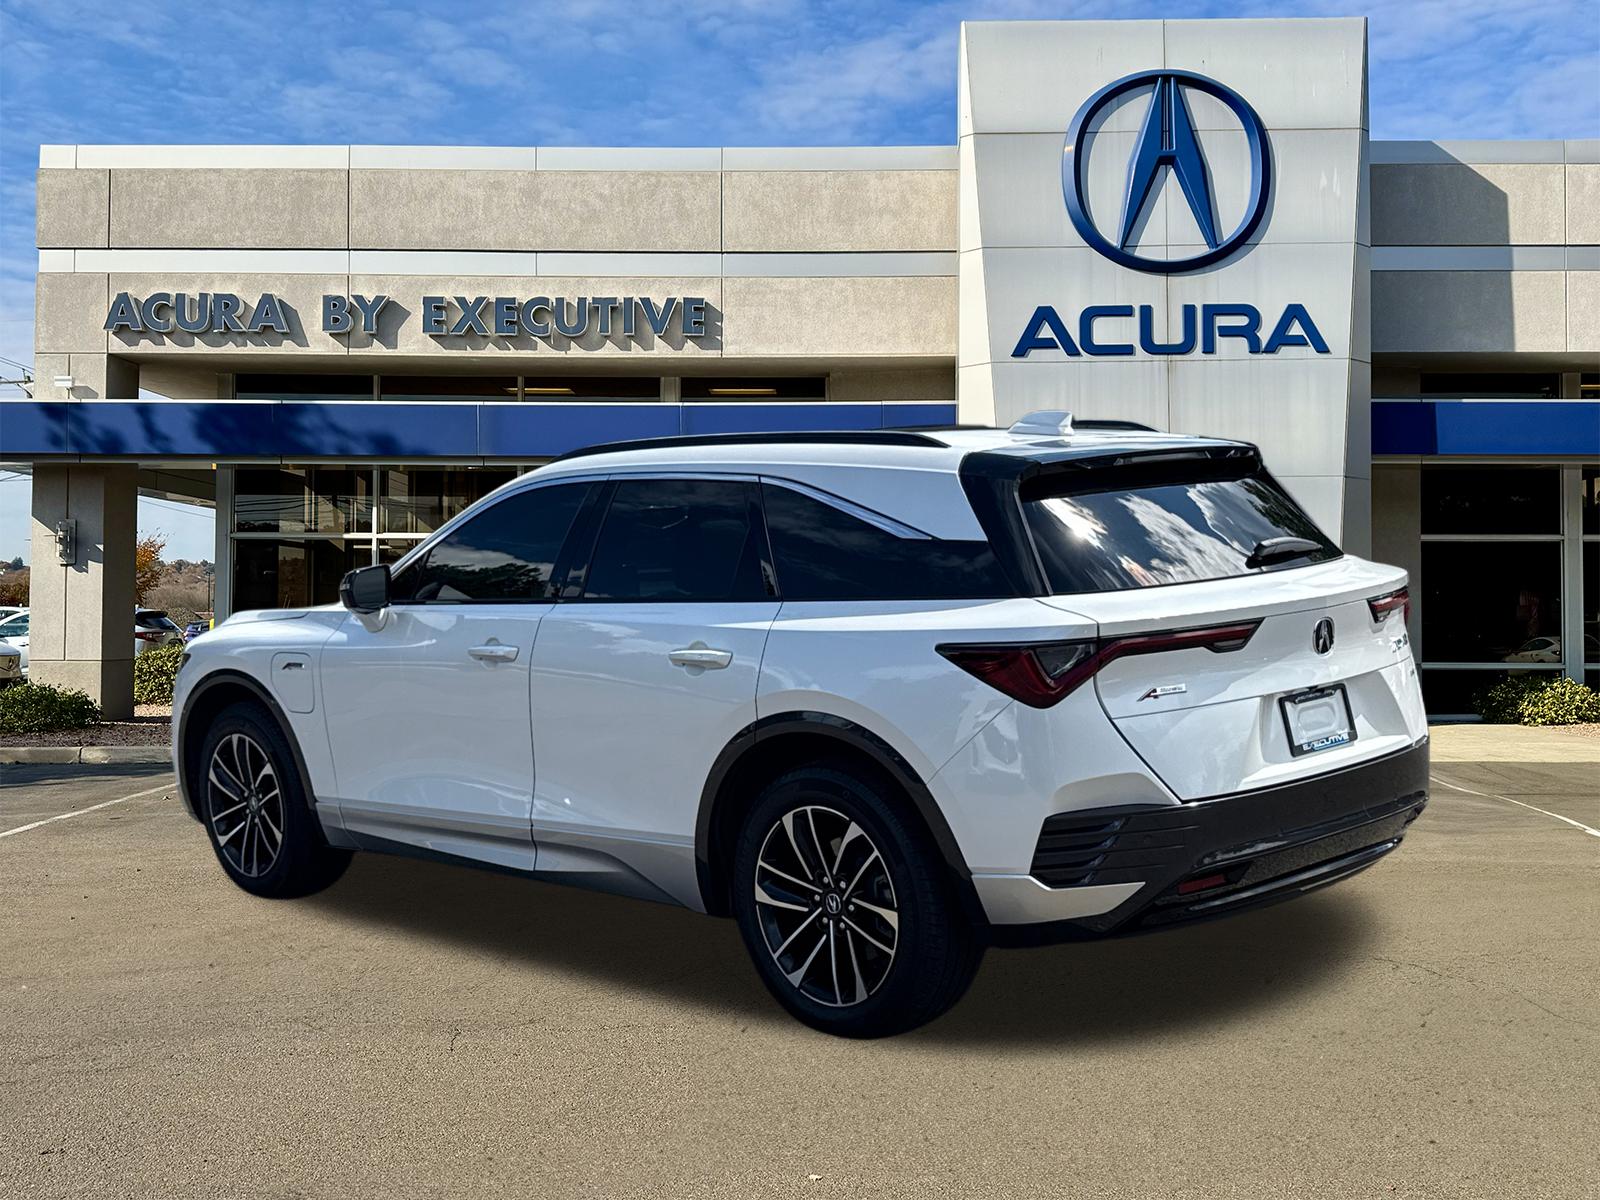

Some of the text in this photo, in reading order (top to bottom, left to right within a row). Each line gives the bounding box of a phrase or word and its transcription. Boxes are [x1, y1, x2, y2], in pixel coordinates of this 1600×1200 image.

[103, 292, 707, 337] ACURA BY EXECUTIVE
[1010, 303, 1332, 357] ACURA
